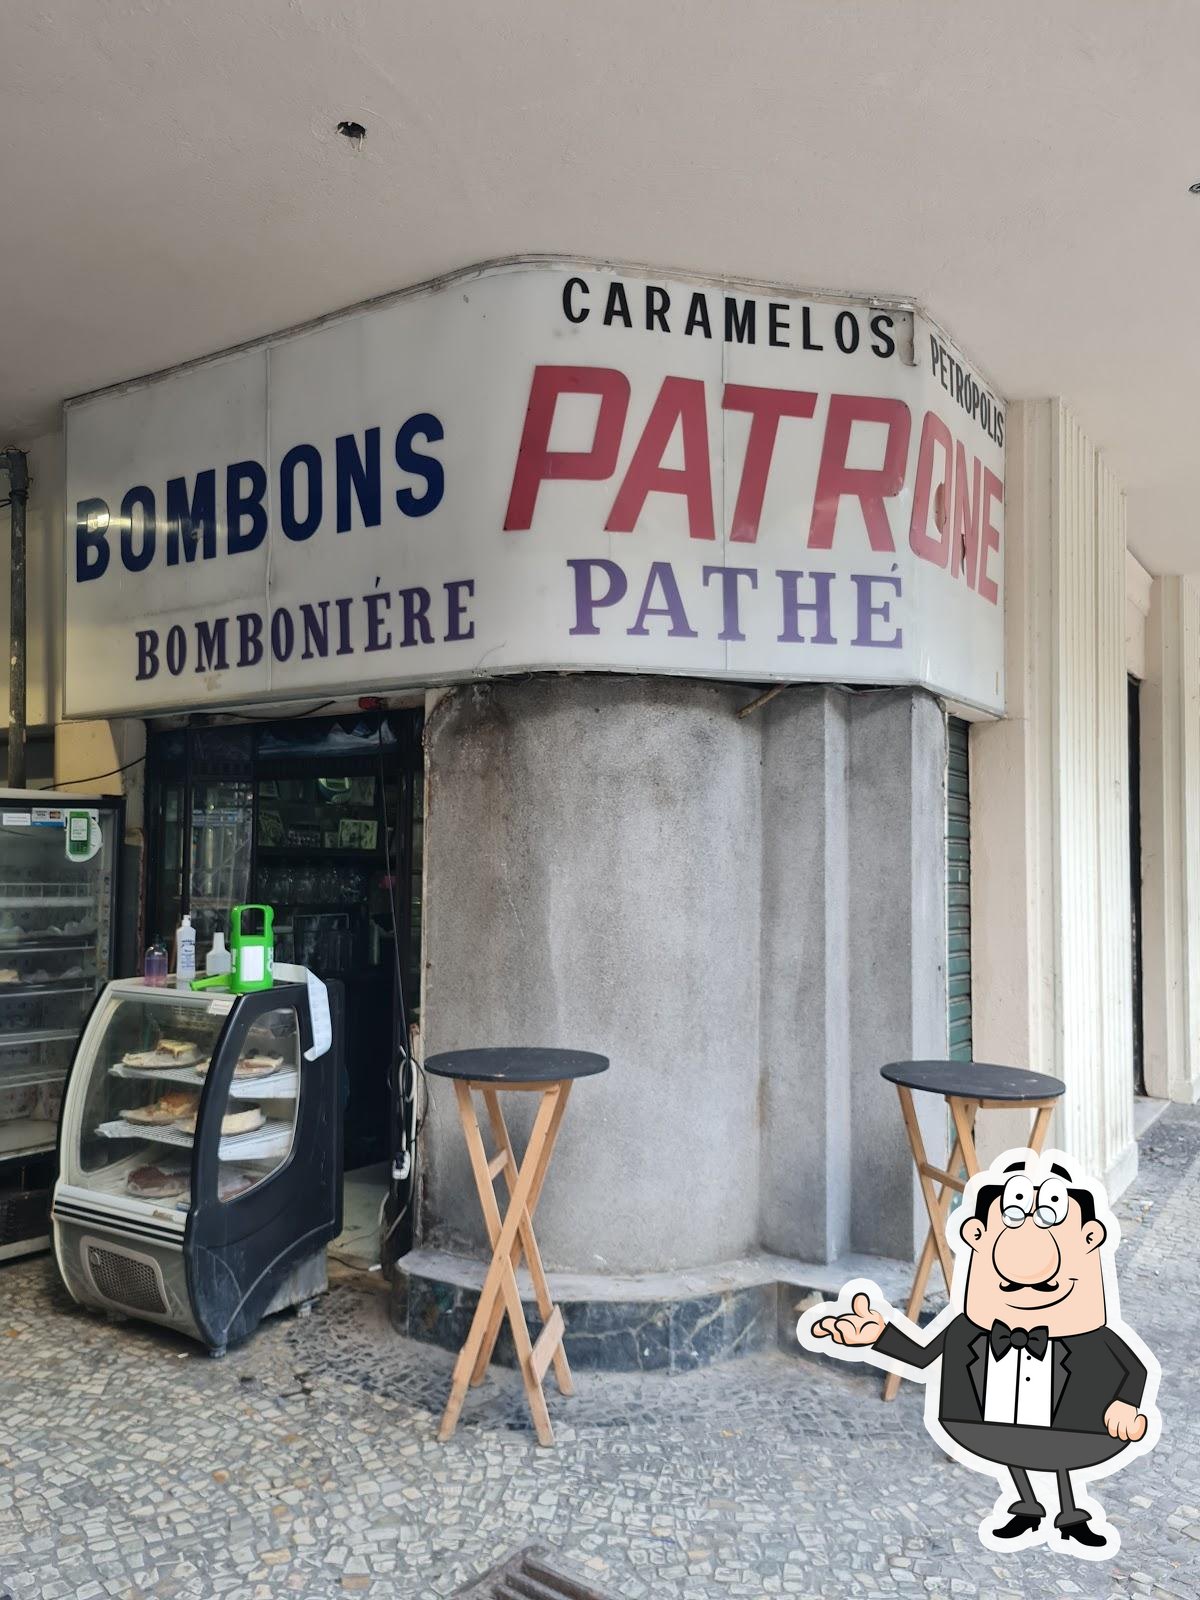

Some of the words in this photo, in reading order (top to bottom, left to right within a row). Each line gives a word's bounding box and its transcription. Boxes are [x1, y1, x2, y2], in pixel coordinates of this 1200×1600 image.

[562, 277, 896, 359] CARAMELOS
[929, 333, 1004, 449] PETRÓPOLIS
[75, 412, 445, 583] BOMBONS
[502, 365, 1004, 607] PATRONE
[134, 577, 476, 682] BOMBONIÉRE
[566, 558, 903, 650] PATHÉ
